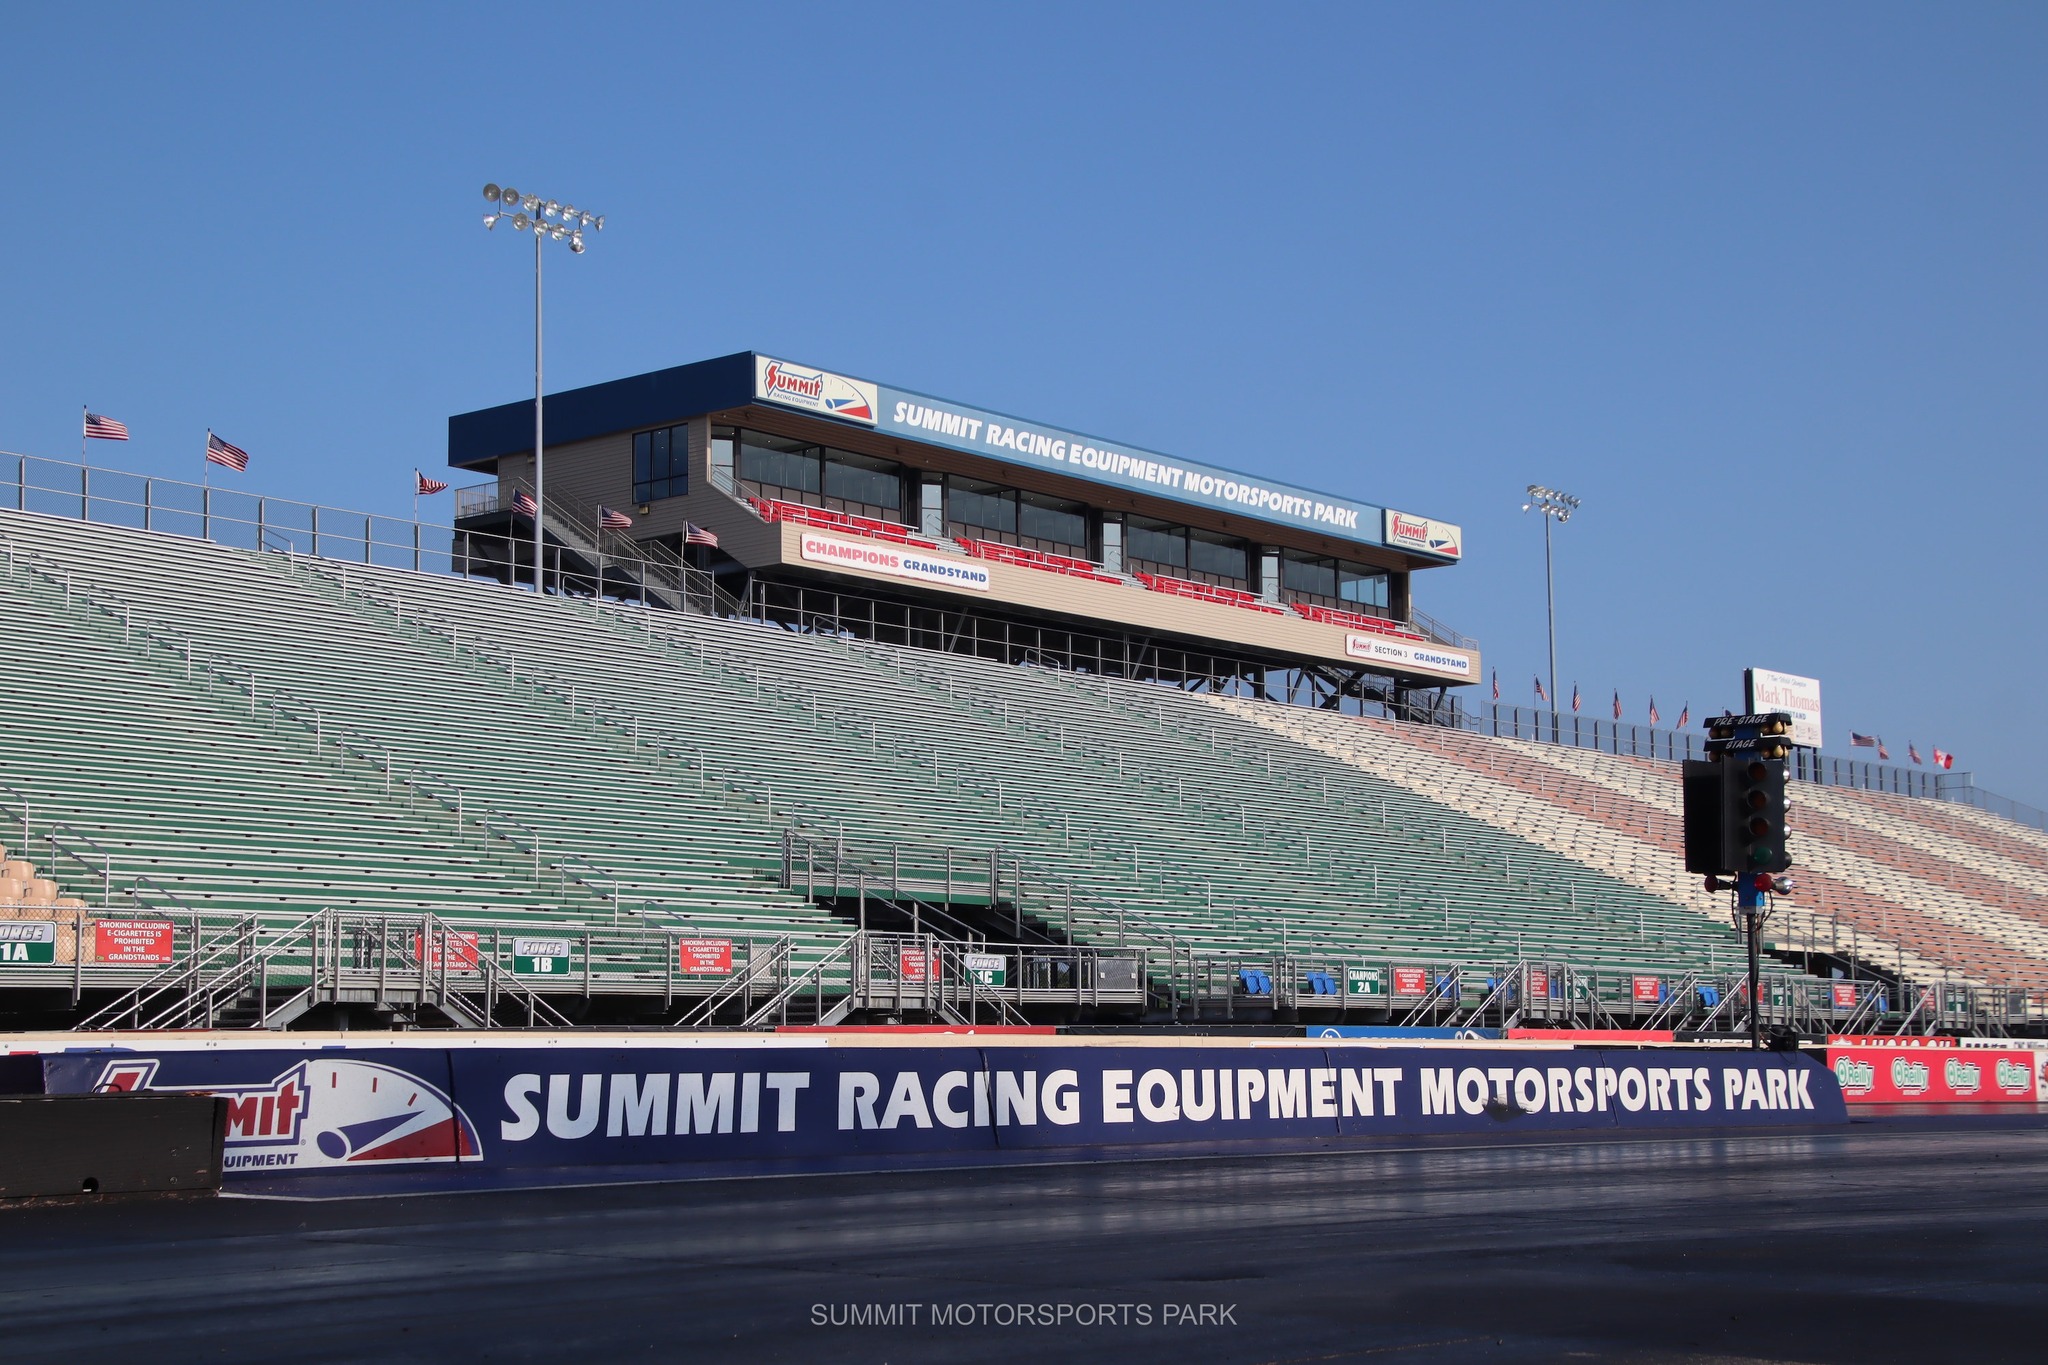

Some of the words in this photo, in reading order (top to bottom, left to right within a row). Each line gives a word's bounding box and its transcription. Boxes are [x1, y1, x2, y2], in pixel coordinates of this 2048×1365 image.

[893, 401, 982, 440] SUMMIT
[985, 423, 1066, 461] RACING
[1068, 443, 1183, 488] EQUIPMENT
[1184, 471, 1311, 519] MOTORSPORTS
[1313, 503, 1359, 529] PARK
[805, 540, 899, 568] CHAMPIONS
[903, 559, 987, 583] GRANDSTAND
[1374, 645, 1402, 657] SECTION
[1413, 652, 1467, 669] GRANDSTAND
[1755, 682, 1781, 705] Mark
[1781, 687, 1820, 713] Thomas
[1713, 714, 1770, 727] PRE-STAGE
[1725, 738, 1757, 750] STAGE
[0, 925, 45, 940] ORCE
[99, 921, 132, 929] SMOKING
[133, 922, 170, 930] INCLUDING
[113, 937, 155, 945] PROHIBITED
[155, 930, 162, 938] IS
[0, 943, 29, 961] 1A
[522, 941, 562, 956] FORCE
[108, 953, 159, 961] GRANDSTANDS
[970, 957, 1000, 969] FORCE
[531, 957, 553, 973] 1B
[1349, 970, 1378, 981] CHAMPIONS
[1357, 981, 1371, 993] 2A
[501, 1071, 810, 1142] SUMMIT
[837, 1070, 1080, 1130] RACING
[1101, 1068, 1403, 1123] EQUIPMENT
[1420, 1067, 1712, 1117] MOTORSPORTS
[1724, 1068, 1815, 1111] PARK
[223, 1153, 298, 1168] UIPMENT
